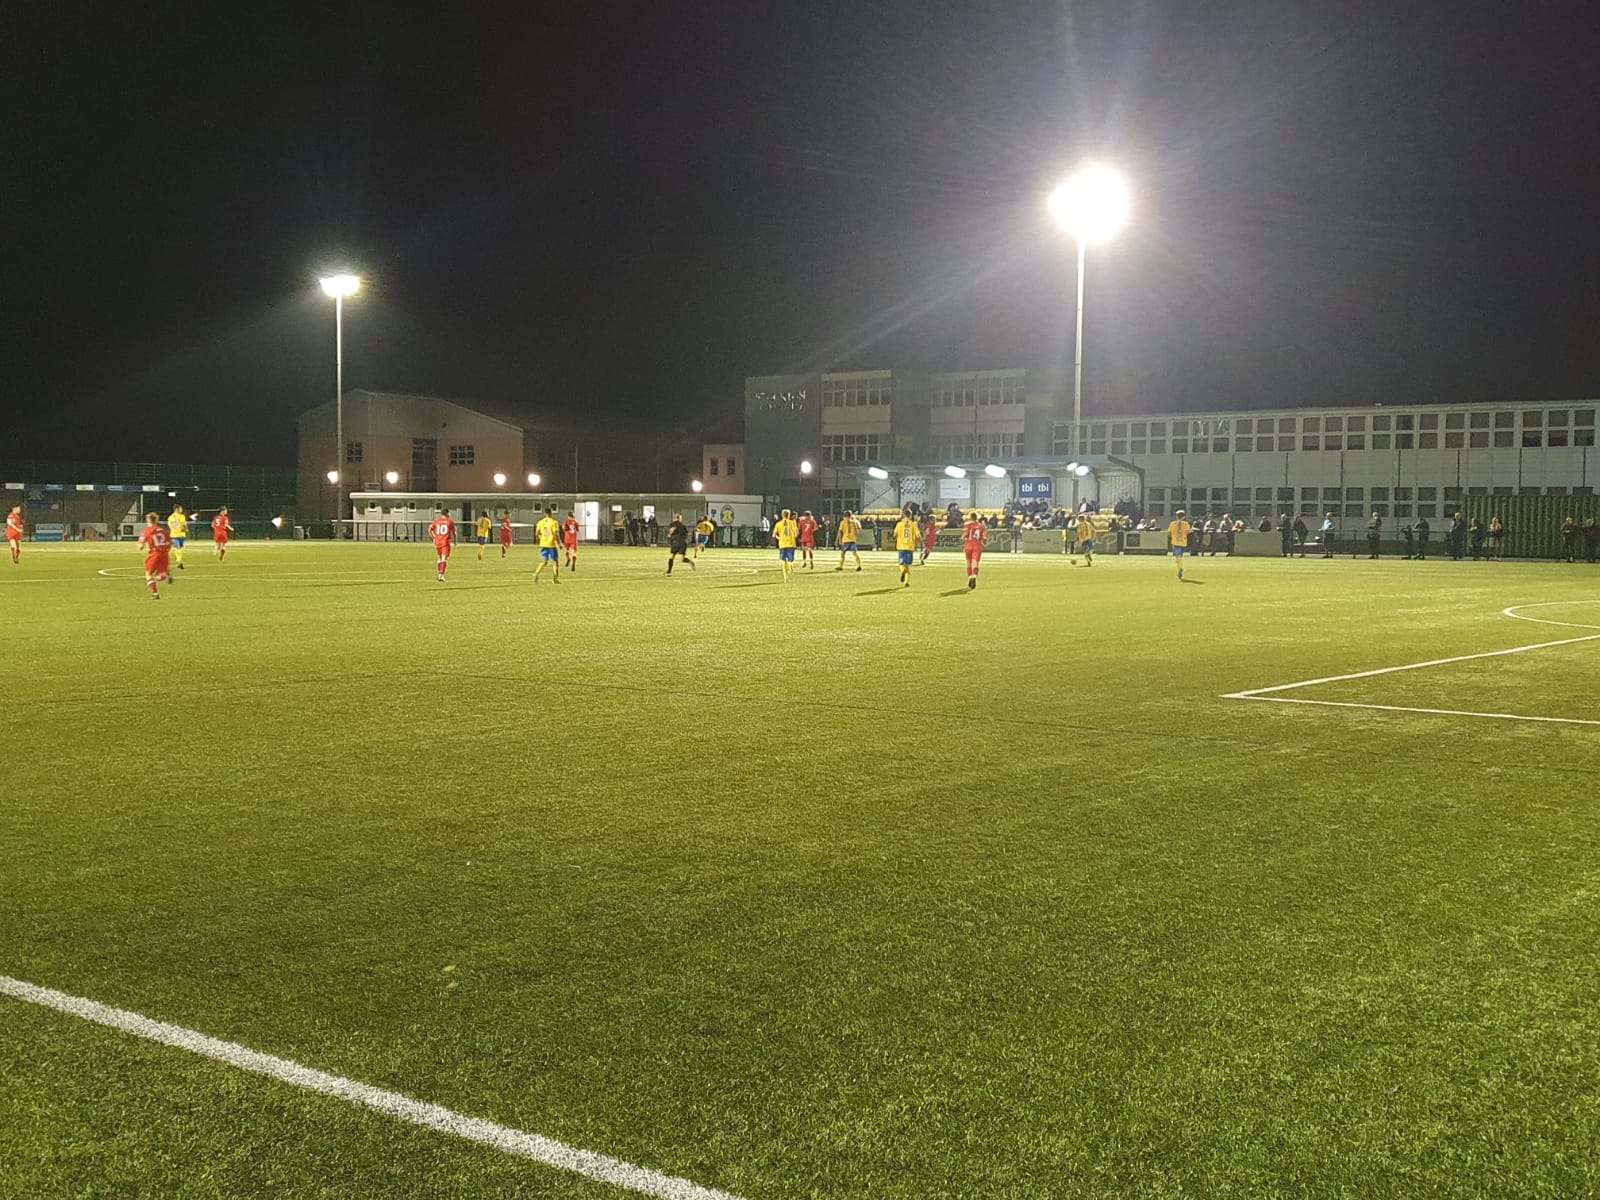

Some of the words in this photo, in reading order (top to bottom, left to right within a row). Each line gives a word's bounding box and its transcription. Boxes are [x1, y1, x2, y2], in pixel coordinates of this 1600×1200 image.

[436, 524, 448, 535] 10
[968, 529, 981, 540] 14
[152, 533, 167, 546] 12
